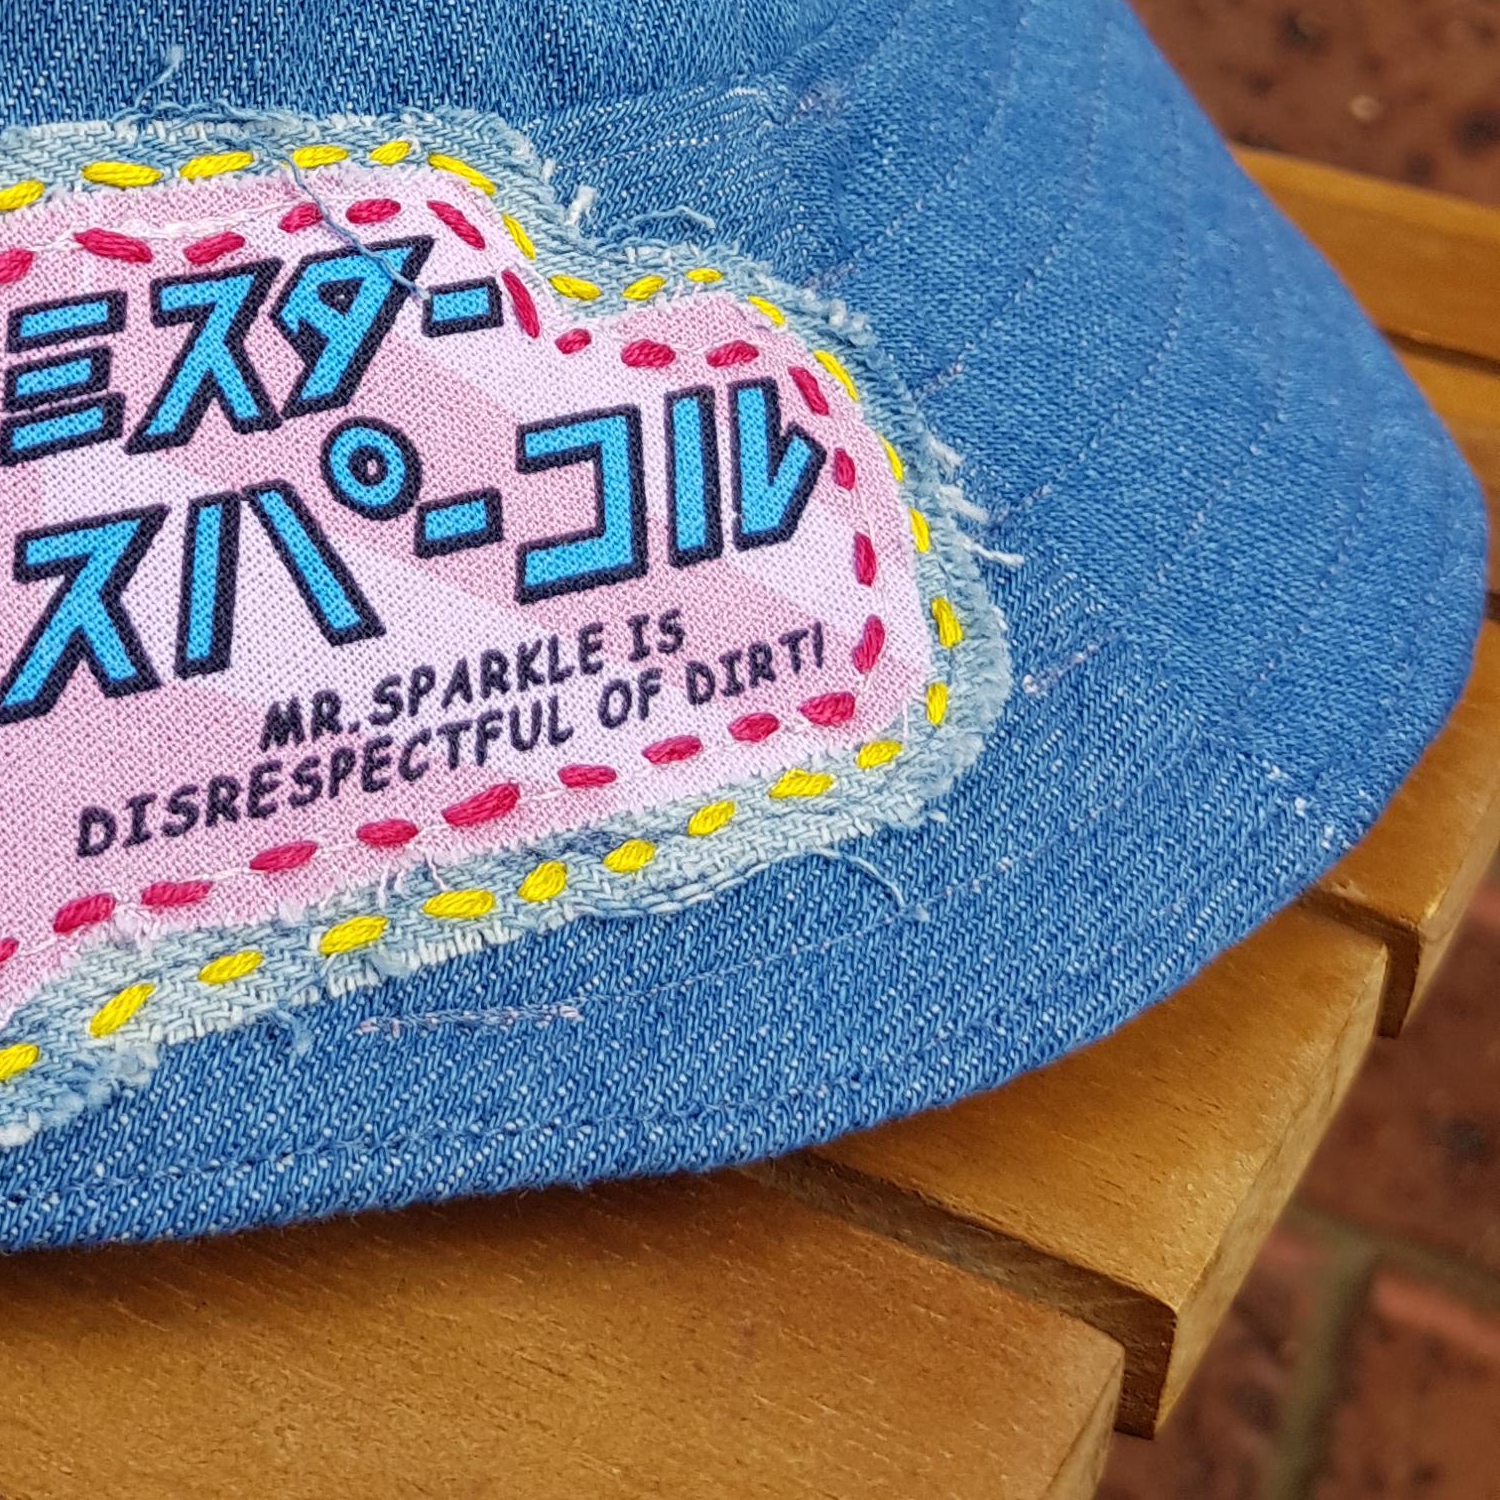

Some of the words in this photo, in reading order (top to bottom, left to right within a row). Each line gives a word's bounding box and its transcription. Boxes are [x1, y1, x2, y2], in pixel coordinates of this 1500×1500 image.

[627, 609, 686, 663] IS
[77, 700, 574, 857] DISRESPECTFUL
[599, 668, 663, 729] OF
[685, 621, 825, 706] DIRT!
